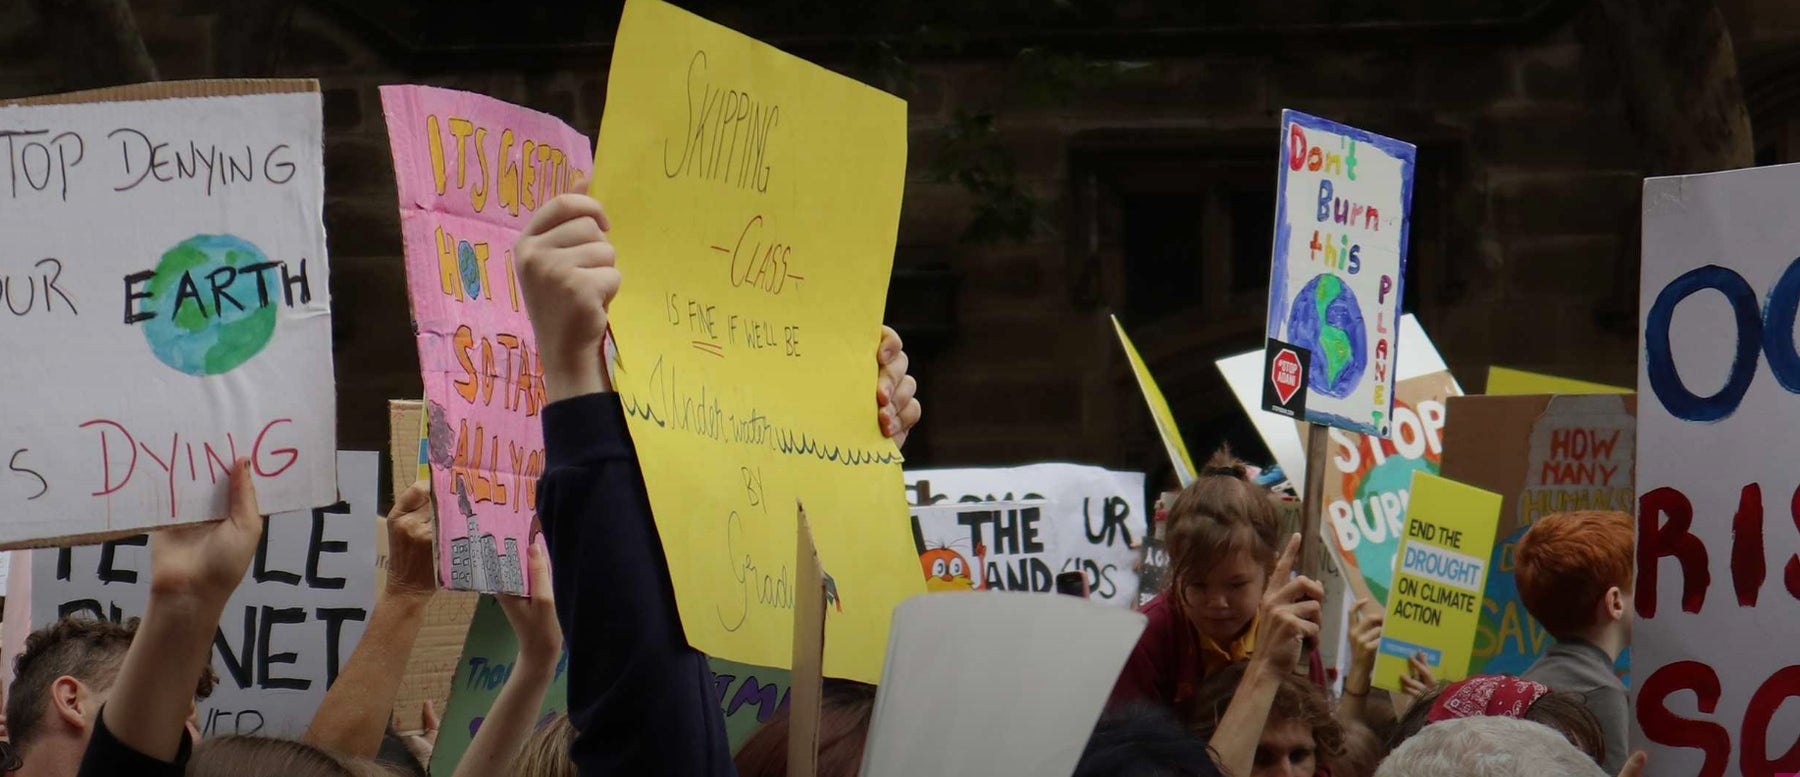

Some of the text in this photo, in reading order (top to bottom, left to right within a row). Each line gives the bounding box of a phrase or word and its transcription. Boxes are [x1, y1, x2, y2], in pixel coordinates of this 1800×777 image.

[663, 49, 779, 194] SKIPPING
[0, 127, 297, 202] TOP DENYING
[426, 114, 490, 213] ITS
[1289, 124, 1358, 181] Don't
[1317, 179, 1379, 231] Burn
[1309, 230, 1361, 275] this
[0, 258, 312, 325] UR EARTH
[665, 291, 680, 326] IS
[688, 299, 718, 341] FINE
[727, 315, 738, 345] IF
[784, 326, 801, 358] BE
[79, 418, 298, 518] DYING
[1551, 429, 1620, 460] HOW
[741, 466, 767, 514] BY
[1541, 462, 1618, 486] MANY
[957, 507, 1044, 557] THE
[1329, 489, 1410, 551] BUR
[1408, 519, 1463, 549] END THE
[1403, 546, 1480, 586] DROUGHT
[1394, 600, 1442, 627] ACTION
[1398, 577, 1476, 613] ON CLIMATE
